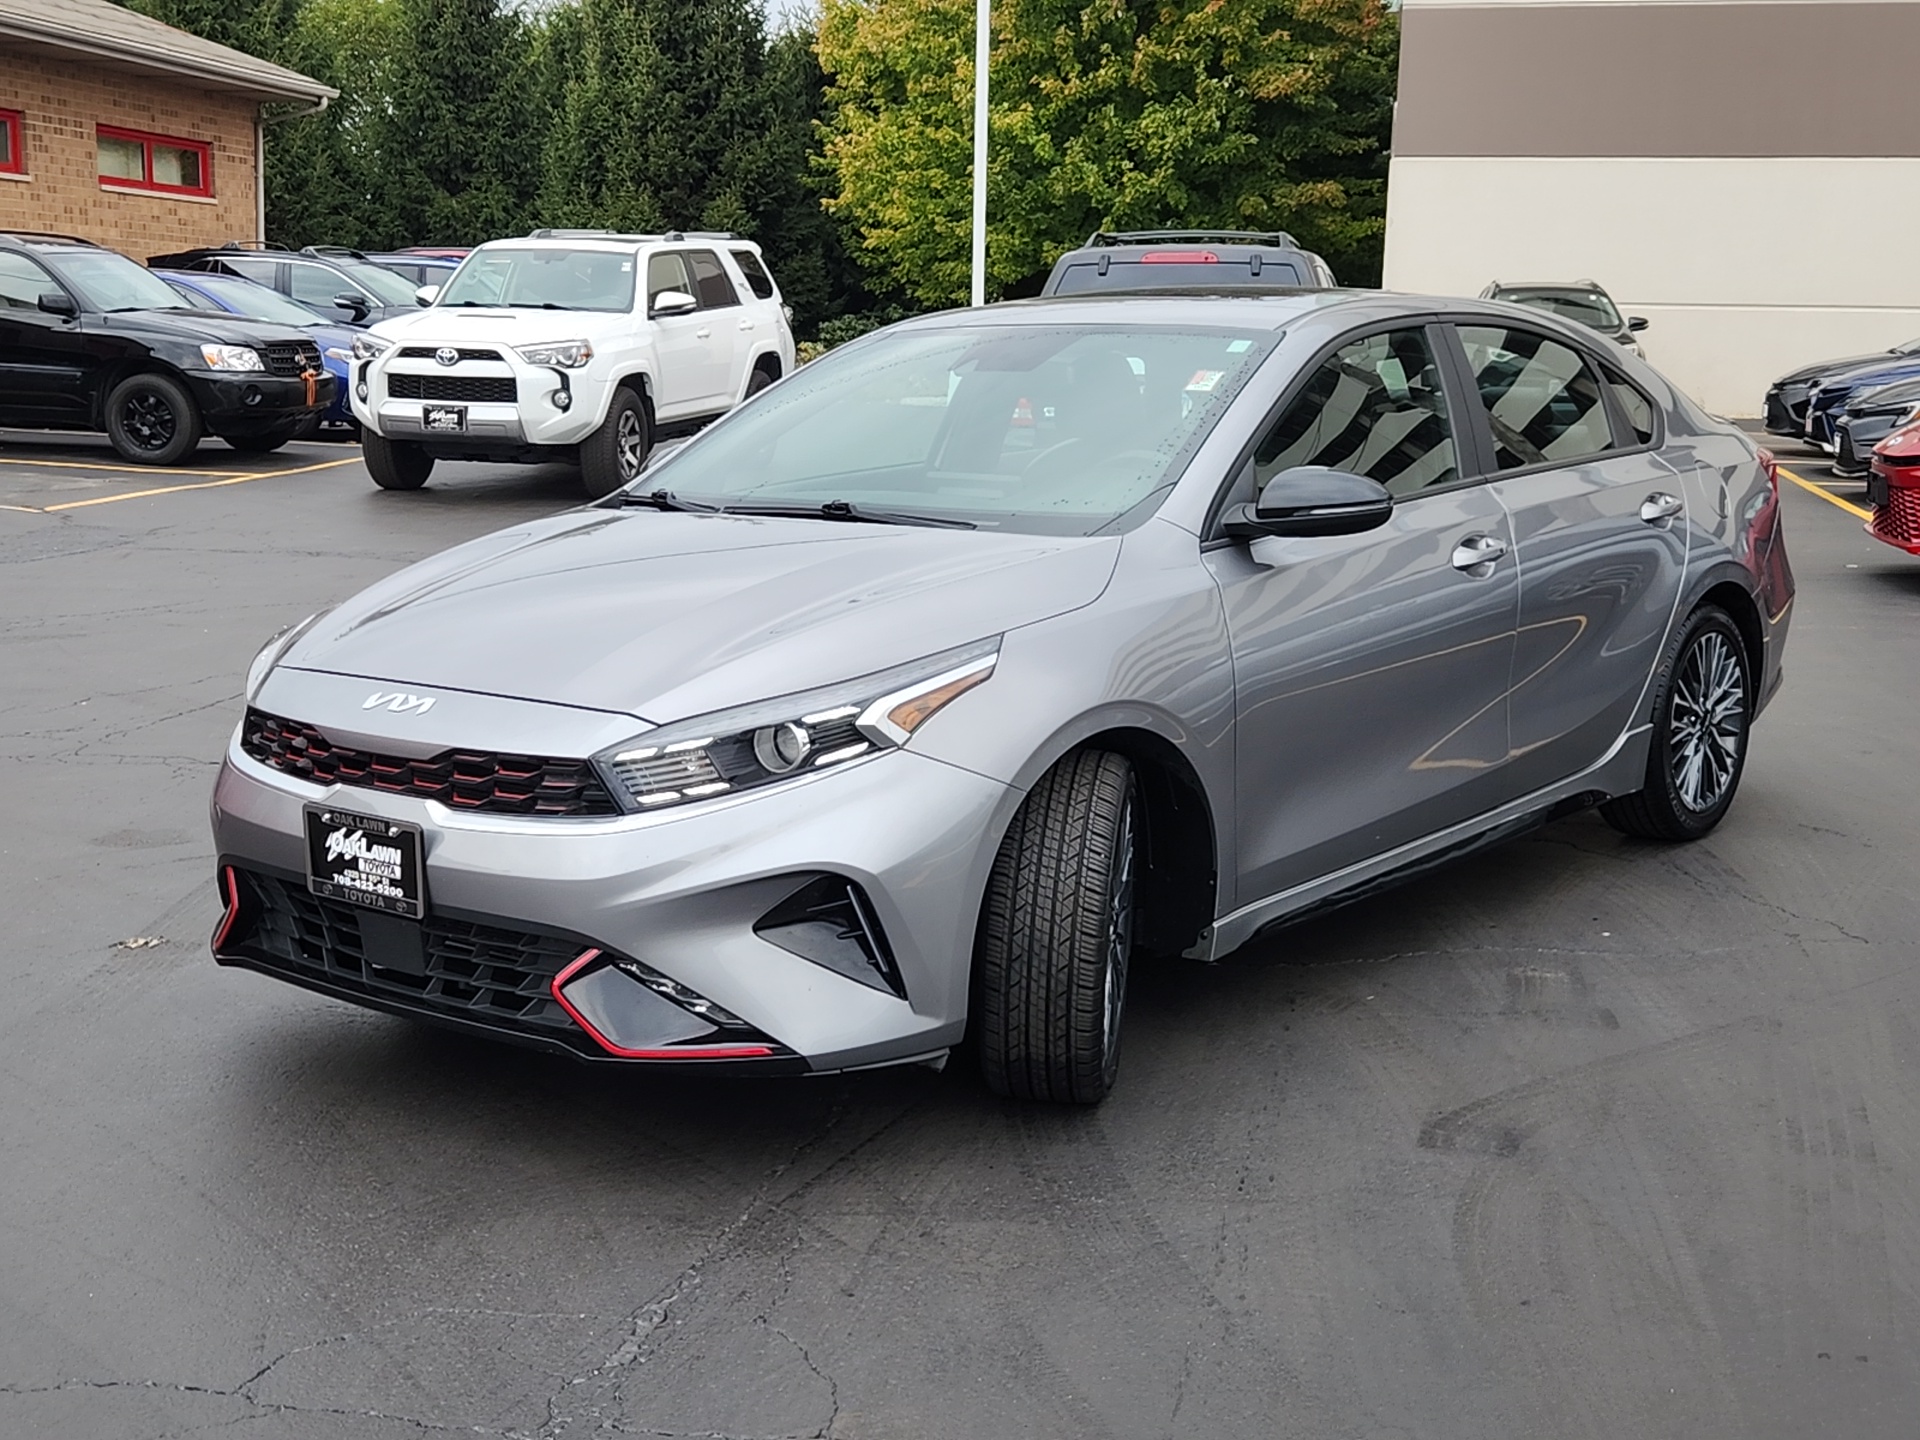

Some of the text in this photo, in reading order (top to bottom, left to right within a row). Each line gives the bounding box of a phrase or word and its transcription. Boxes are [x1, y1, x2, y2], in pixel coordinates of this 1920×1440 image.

[333, 813, 386, 833] OAK LAWN
[363, 860, 396, 876] TOYOTA
[343, 888, 385, 908] TOYOTA
